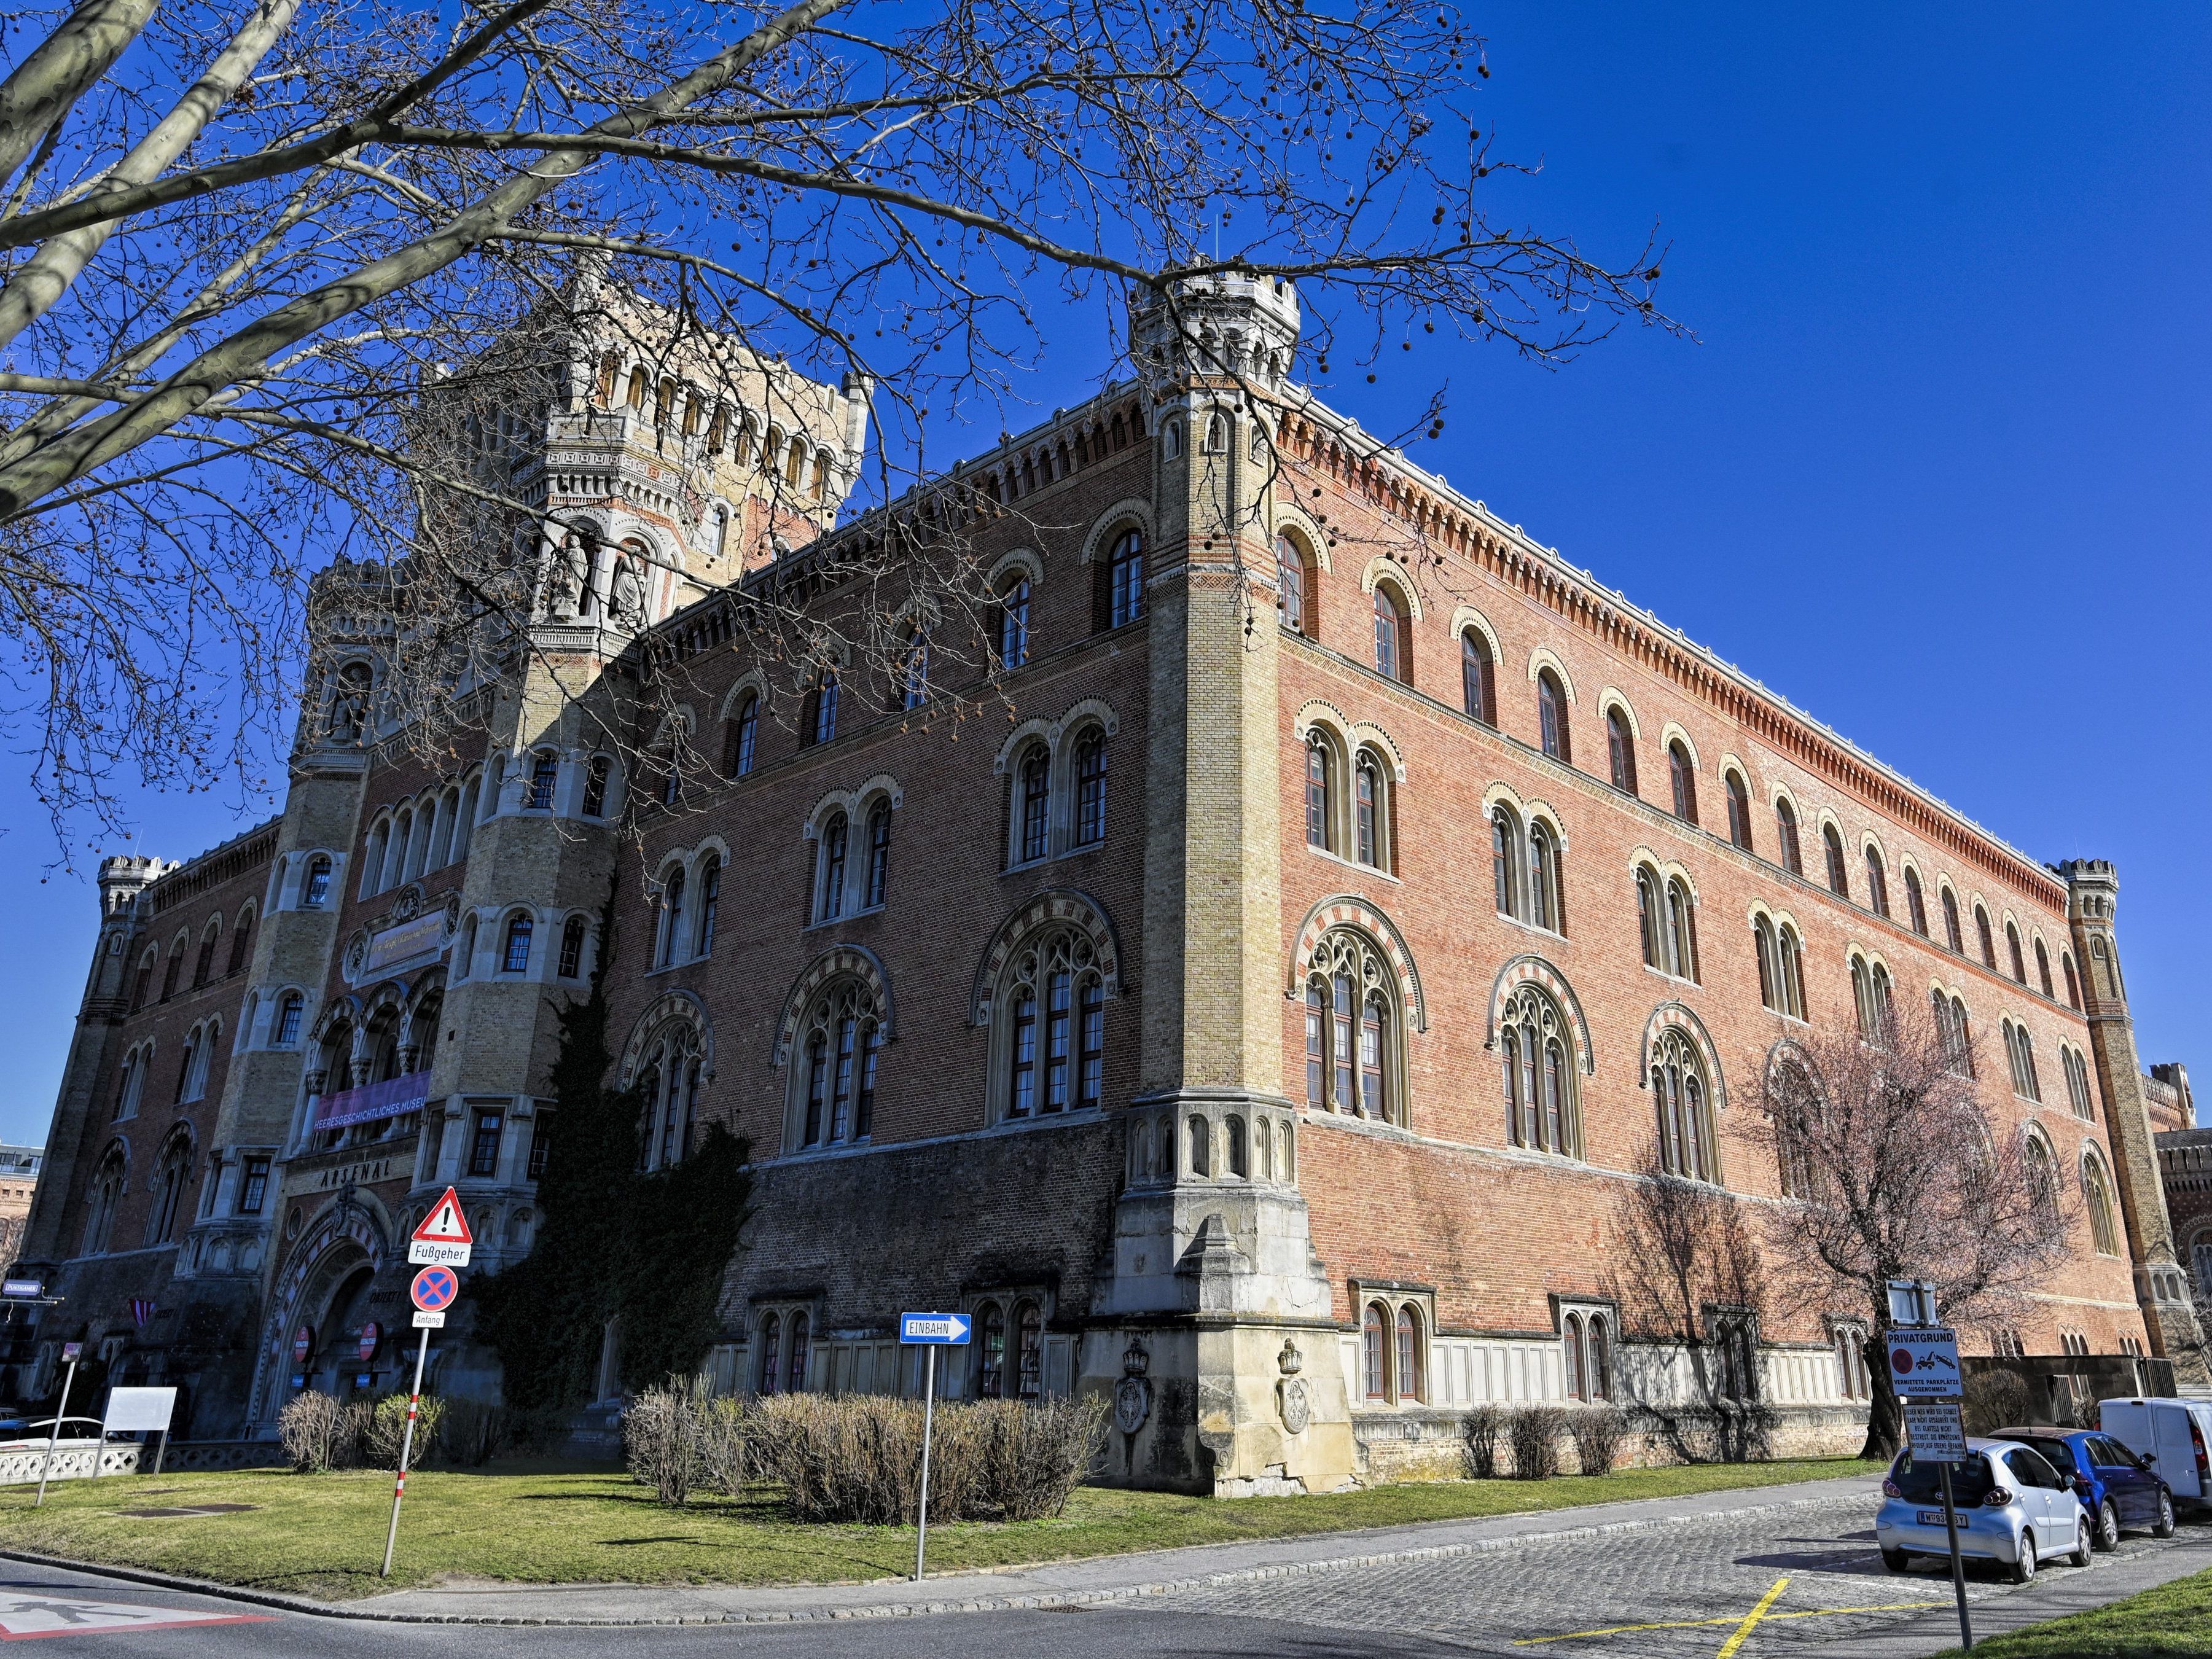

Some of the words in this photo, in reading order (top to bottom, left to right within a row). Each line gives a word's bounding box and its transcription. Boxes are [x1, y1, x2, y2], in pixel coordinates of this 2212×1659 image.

[314, 1103, 399, 1130] HEERESGESCHICHTLICHES
[401, 1096, 427, 1112] MUSEU
[321, 1160, 389, 1187] ARSENAL
[415, 1245, 465, 1262] Fußgeher
[416, 1315, 440, 1326] Anfang
[910, 1322, 949, 1335] EINBAHN
[1888, 1333, 1953, 1343] PRIVATGRUND
